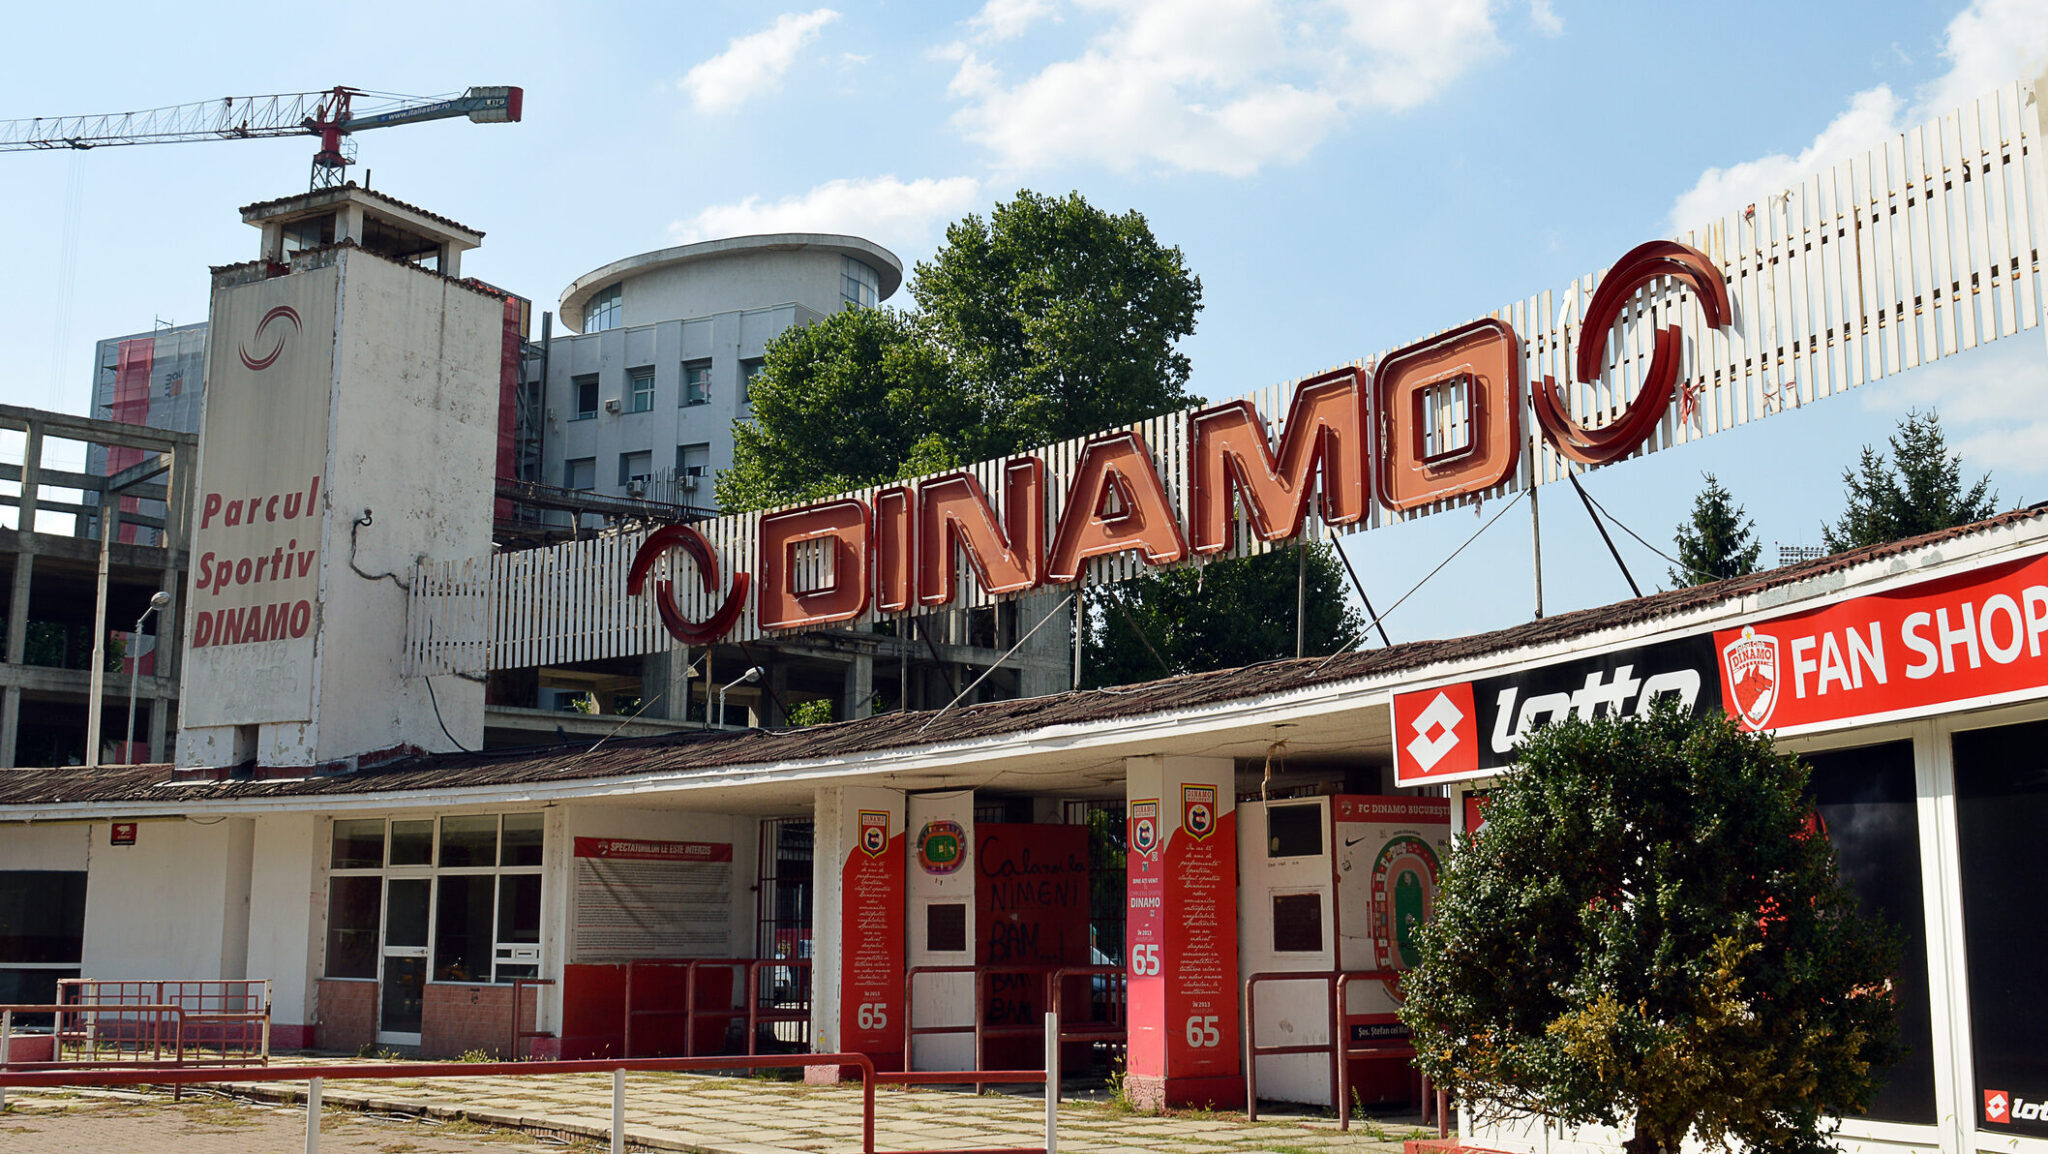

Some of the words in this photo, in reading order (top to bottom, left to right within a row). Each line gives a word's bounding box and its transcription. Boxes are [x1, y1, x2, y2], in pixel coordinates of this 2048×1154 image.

[758, 317, 1519, 631] DINAMO
[201, 476, 320, 529] Parcul
[196, 539, 315, 596] Sportiv
[193, 600, 311, 648] DINAMO
[1732, 647, 1772, 667] DINAMO
[1791, 621, 1888, 699] FAN
[1901, 585, 2048, 679] SHOP
[1358, 804, 1370, 813] FC
[1372, 805, 1407, 814] DINAMO
[990, 880, 1078, 912] NIMENI
[1130, 897, 1160, 908] DINAMO
[1132, 944, 1160, 976] 65
[857, 1003, 887, 1030] 65
[1186, 1016, 1220, 1048] 65
